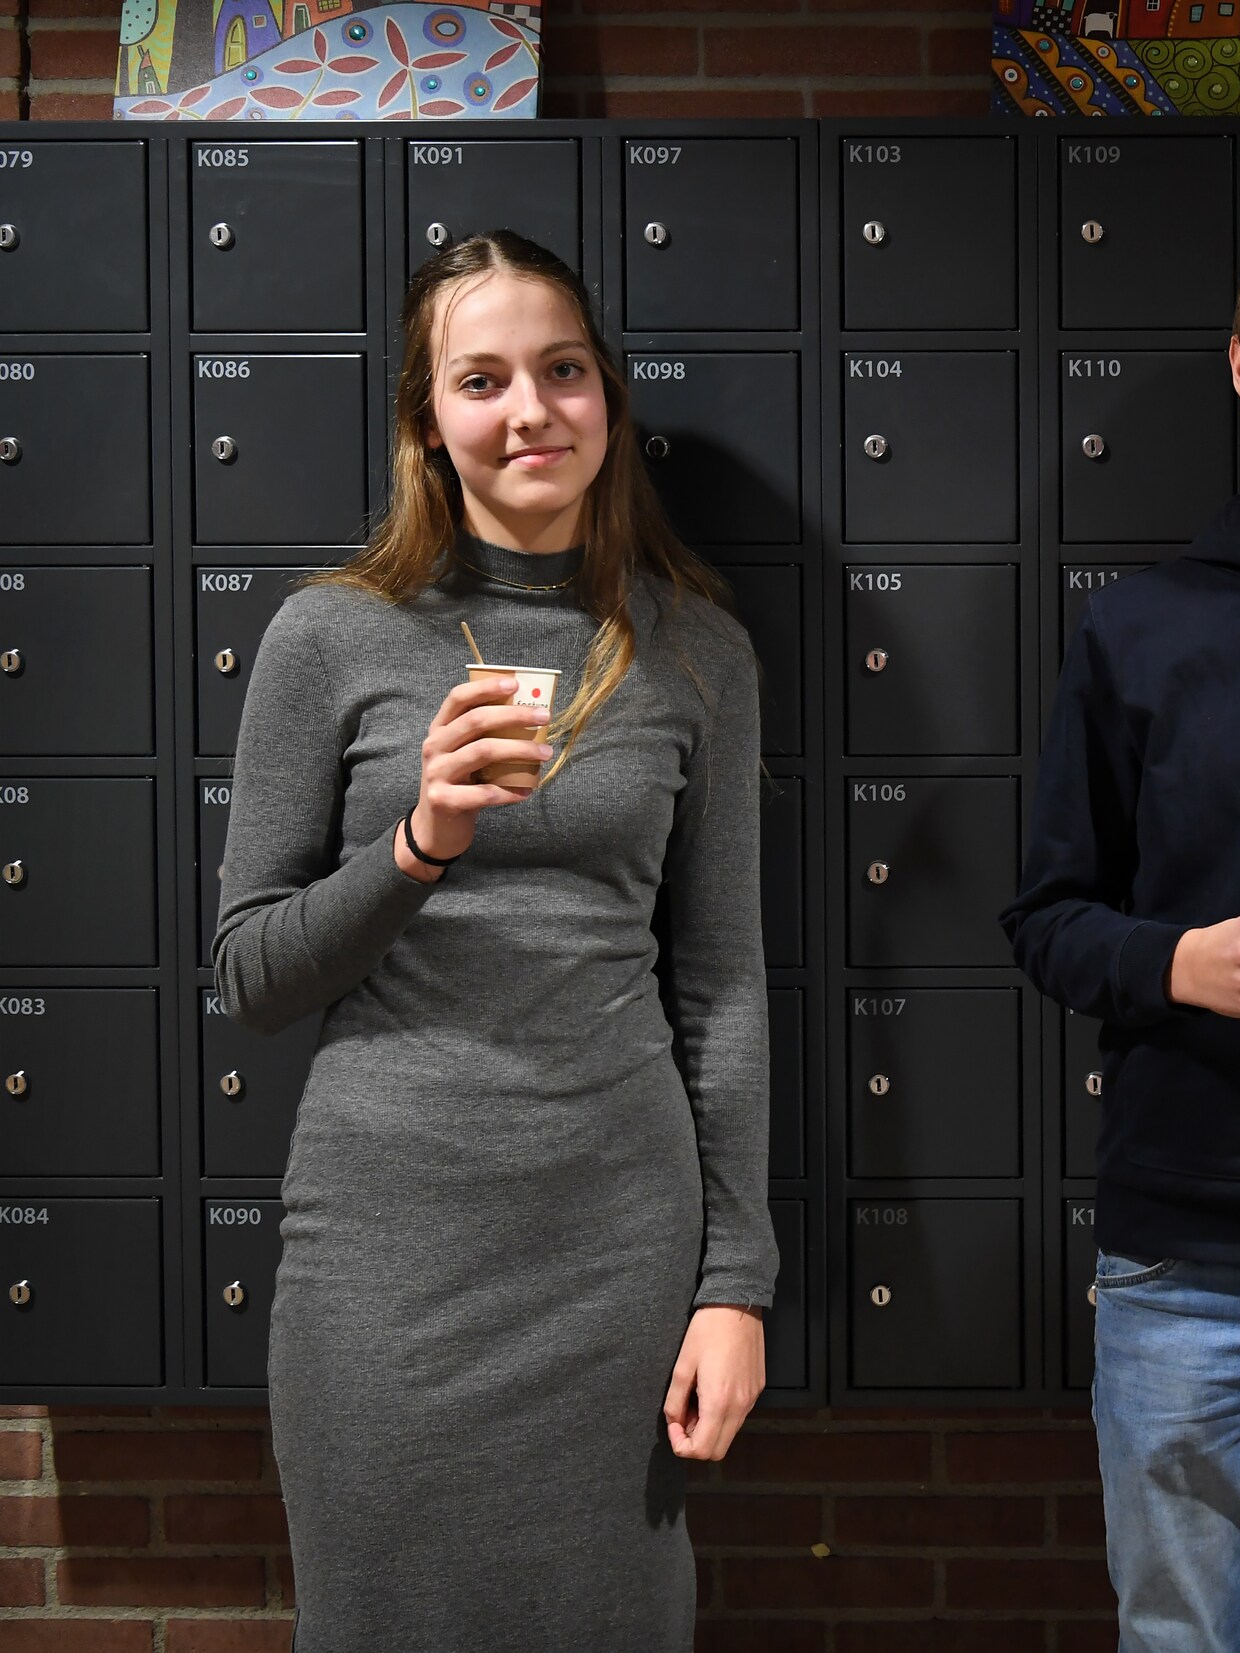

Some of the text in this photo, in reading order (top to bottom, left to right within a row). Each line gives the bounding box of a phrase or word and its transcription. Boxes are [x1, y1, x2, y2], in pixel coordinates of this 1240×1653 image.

[0, 151, 32, 168] 079
[198, 149, 248, 166] K085
[413, 146, 462, 164] K091
[631, 147, 681, 164] K097
[850, 145, 900, 162] K103
[1069, 146, 1120, 163] K109
[0, 363, 34, 380] 080
[199, 361, 250, 378] K086
[634, 362, 685, 379] K098
[851, 360, 902, 377] K104
[1070, 360, 1120, 376] K110
[0, 574, 24, 591] 08
[202, 574, 252, 591] K087
[851, 574, 901, 590] K105
[205, 787, 229, 804] K0
[855, 784, 905, 801] K106
[855, 999, 906, 1015] K107
[0, 1207, 49, 1224] K084
[211, 1208, 261, 1224] K090
[857, 1208, 907, 1225] K108
[1073, 1208, 1094, 1225] K1
